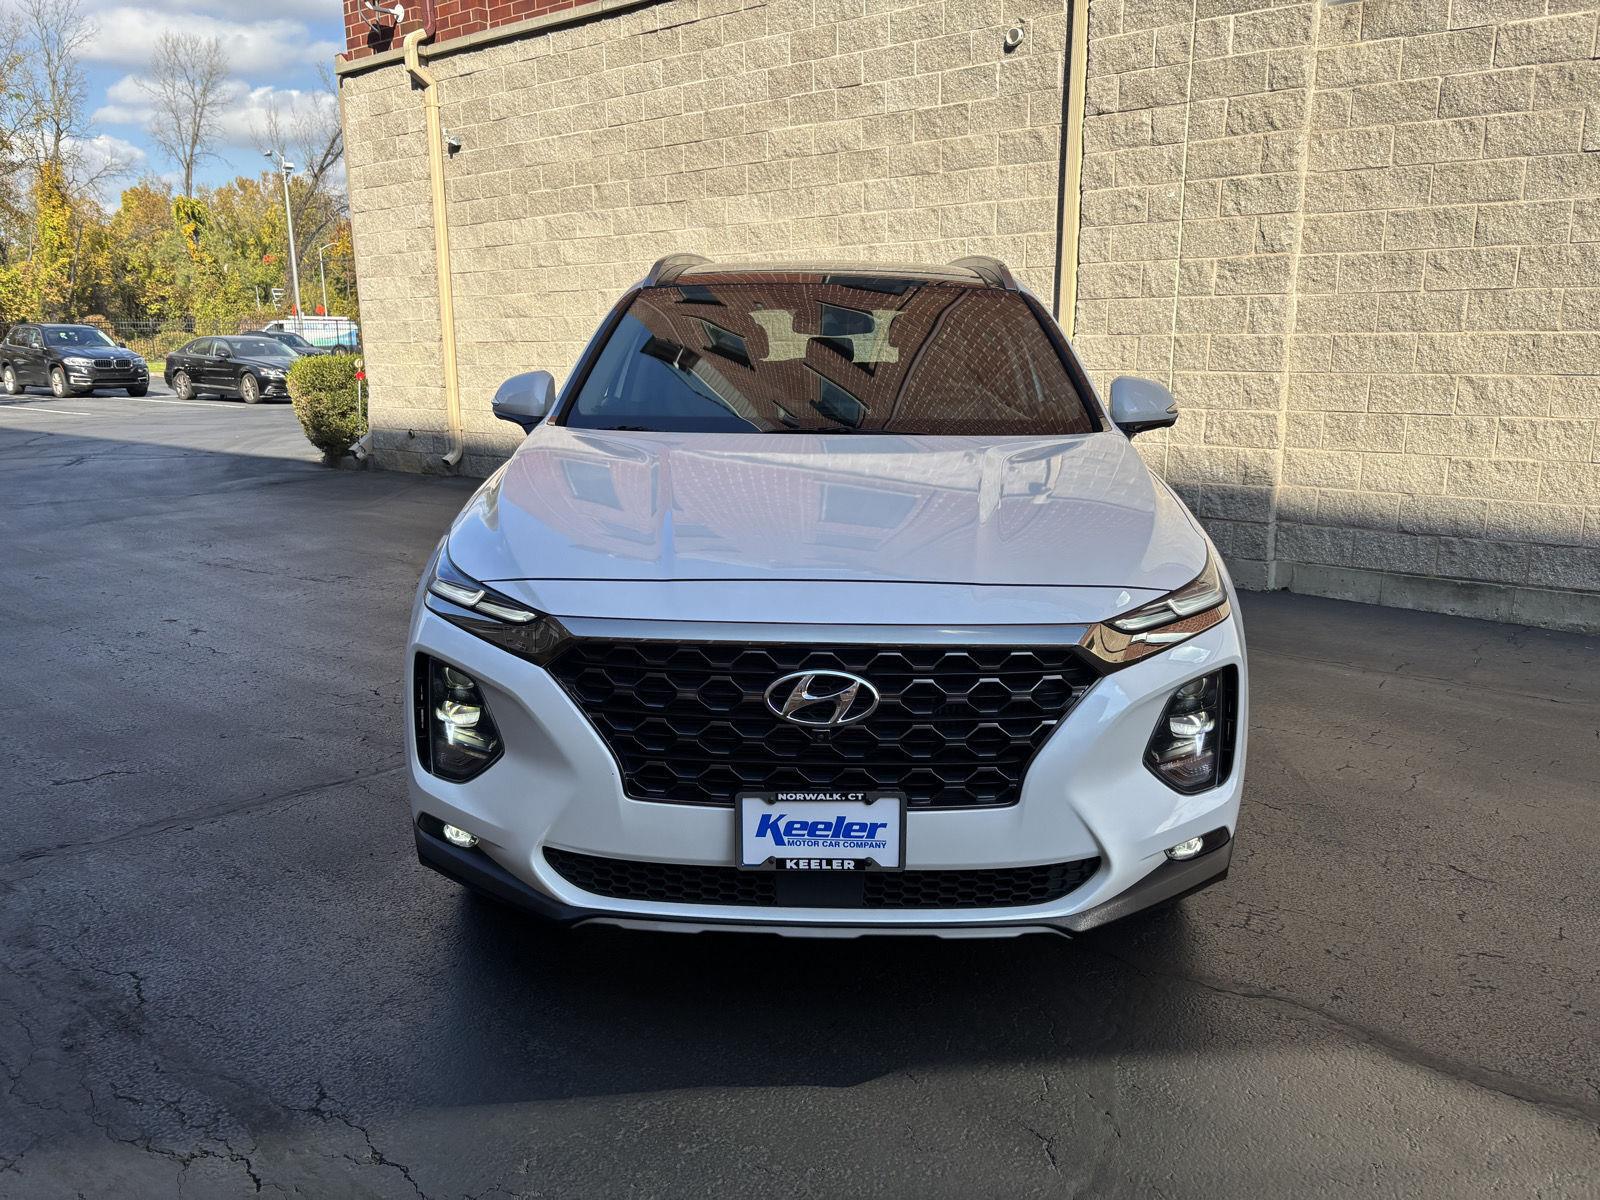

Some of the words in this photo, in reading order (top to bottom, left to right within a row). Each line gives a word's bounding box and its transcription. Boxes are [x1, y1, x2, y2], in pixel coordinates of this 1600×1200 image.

[755, 814, 888, 846] Keeler
[787, 840, 820, 848] MOTOR
[822, 840, 841, 848] CAR
[843, 841, 887, 849] COMPANY
[785, 859, 855, 870] KEELER
